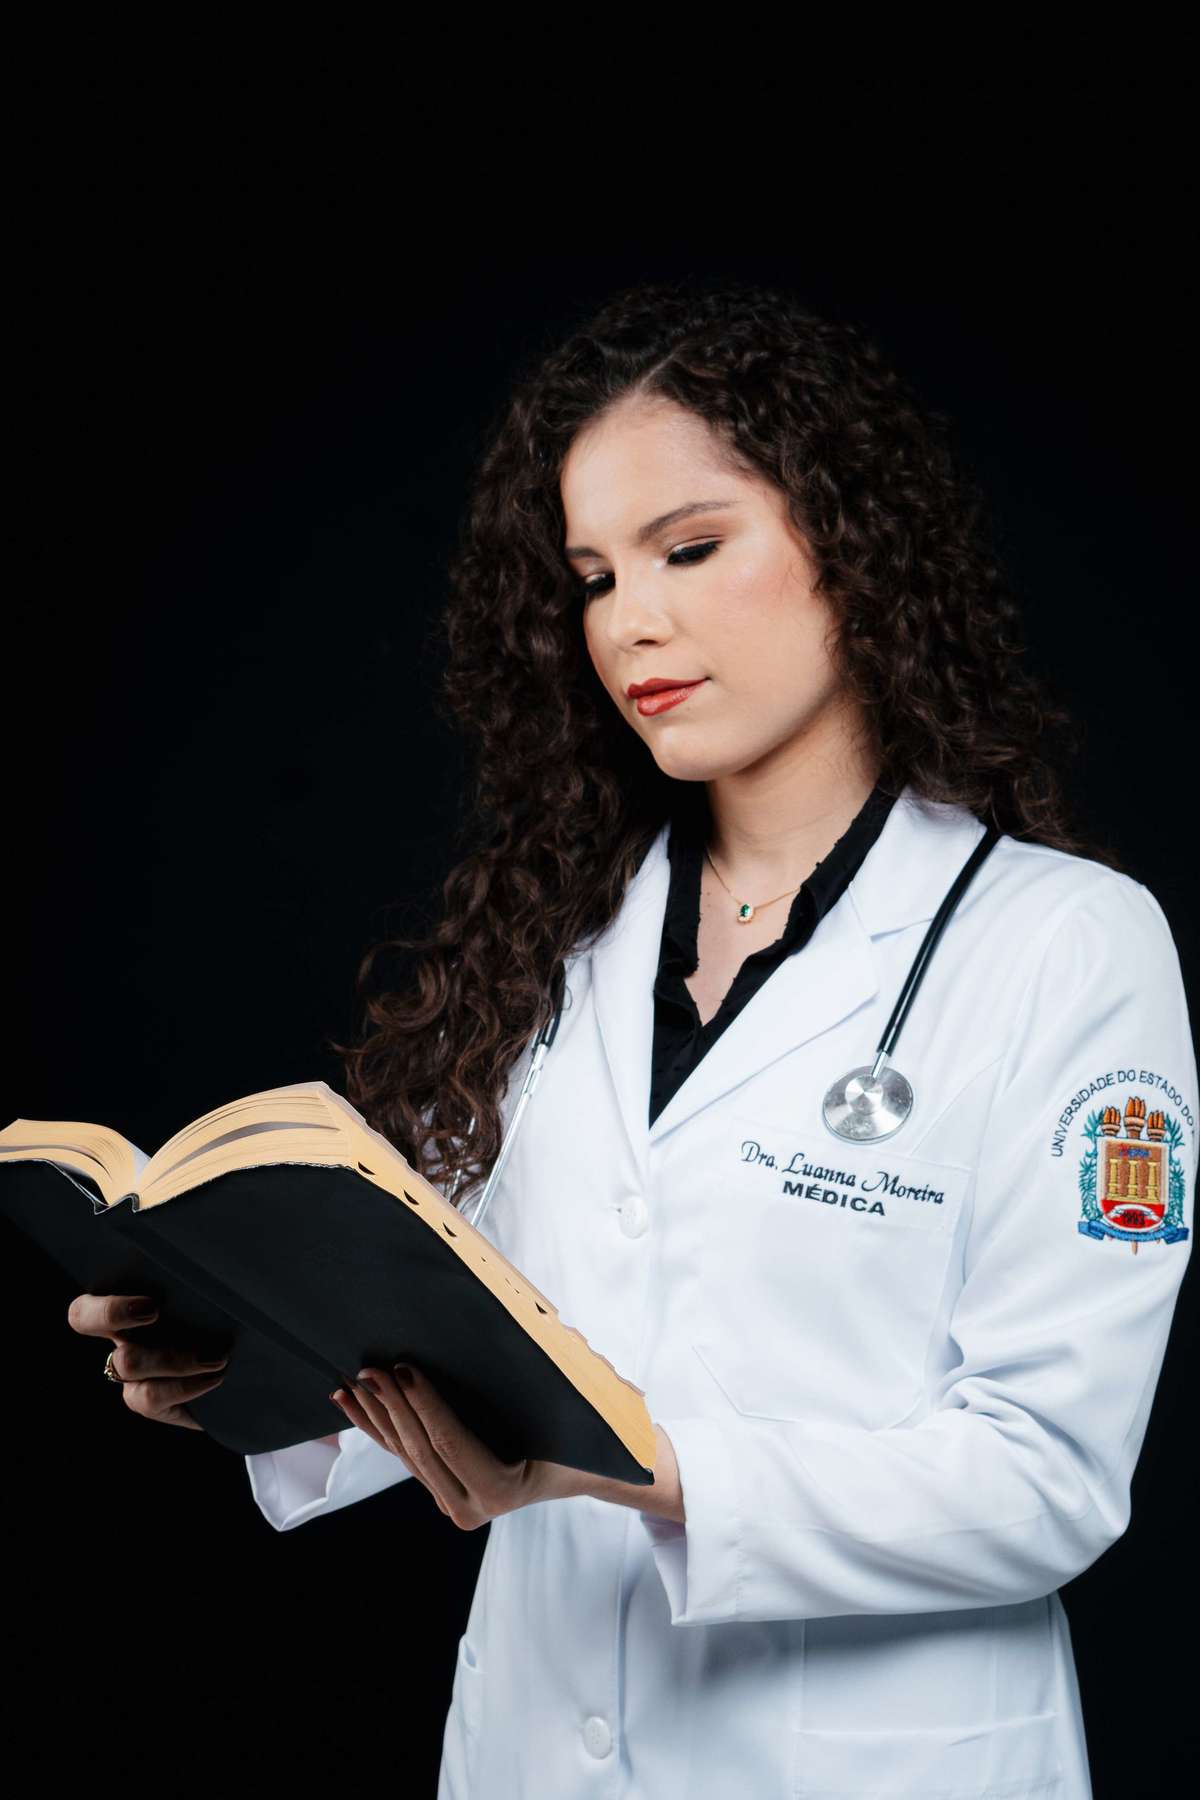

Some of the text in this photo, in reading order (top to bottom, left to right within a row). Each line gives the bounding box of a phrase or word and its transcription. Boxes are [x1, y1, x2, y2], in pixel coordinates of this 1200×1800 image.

[1051, 1069, 1193, 1157] UNIVERSIDADE DO ESTADO DO
[741, 1140, 945, 1205] Dra. Luanna Moreira
[782, 1180, 886, 1216] MÉDICA
